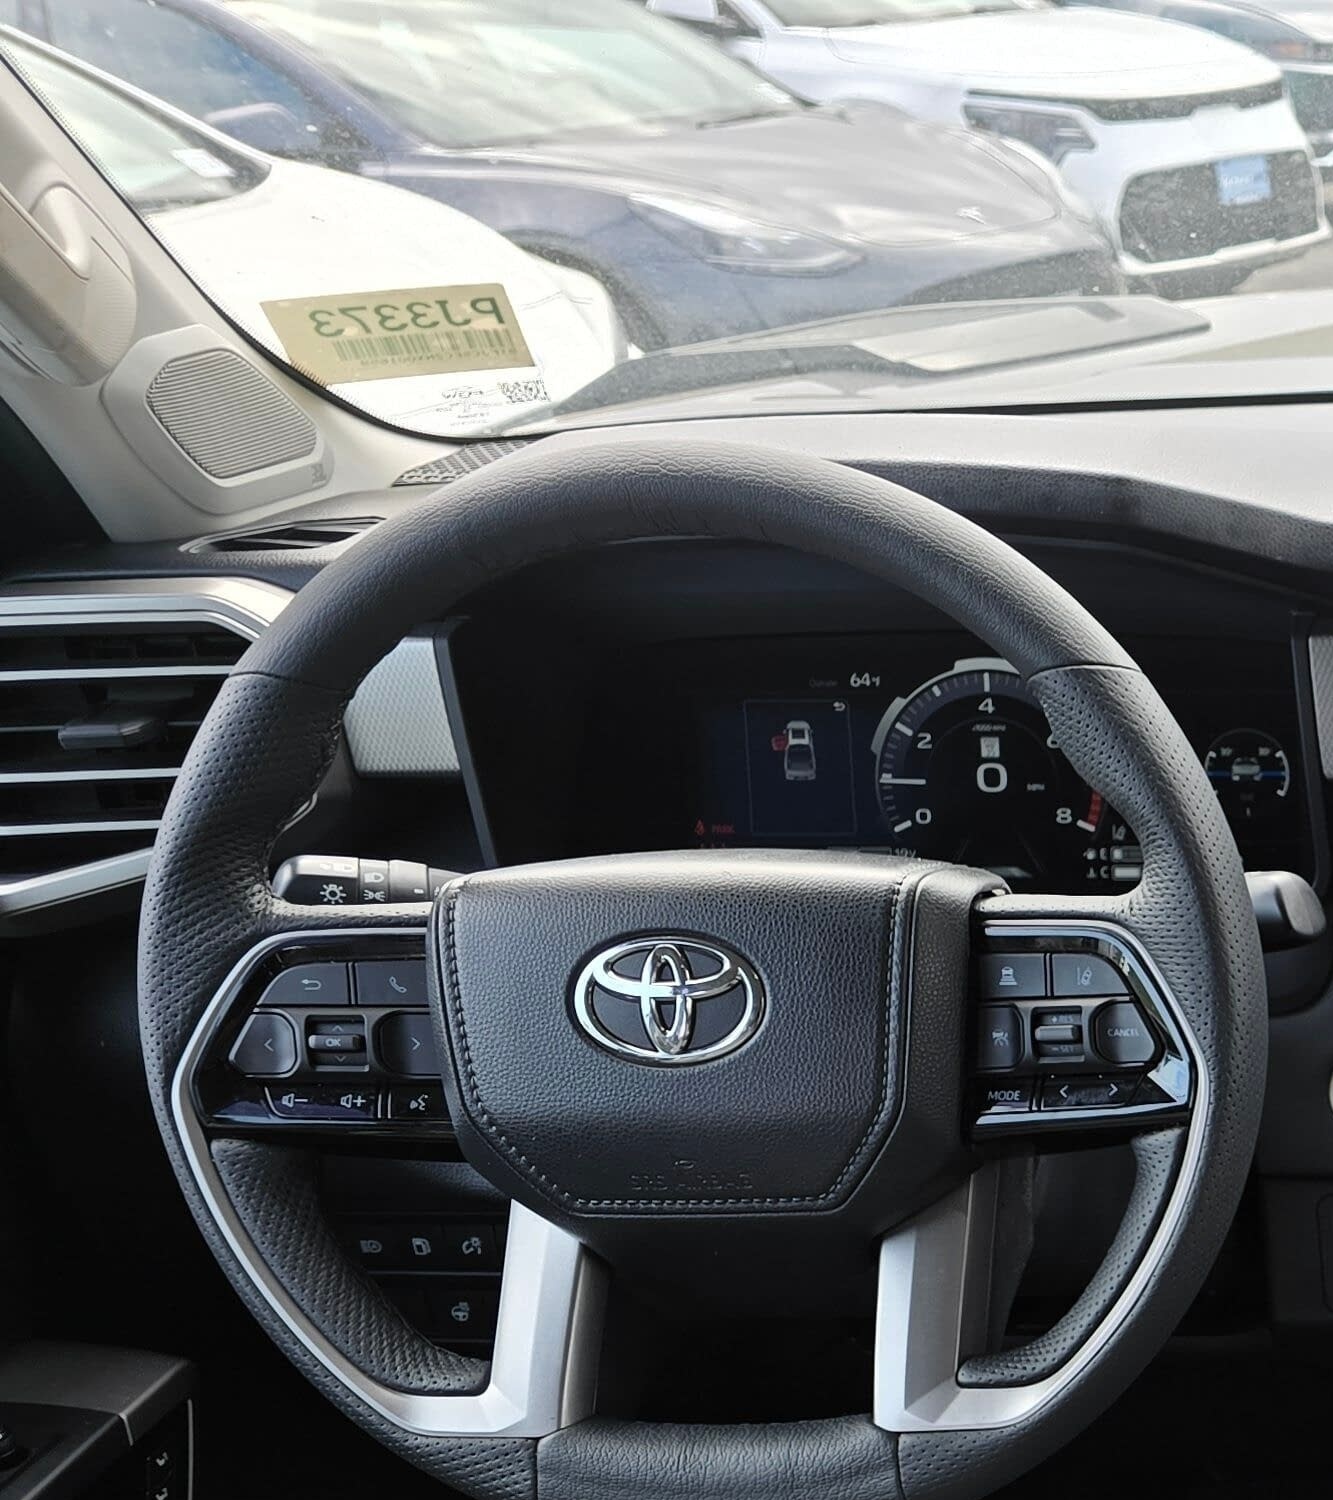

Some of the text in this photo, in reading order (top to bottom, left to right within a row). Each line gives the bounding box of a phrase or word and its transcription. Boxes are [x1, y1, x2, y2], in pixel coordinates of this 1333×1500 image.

[978, 697, 995, 714] 4
[916, 732, 933, 750] 2
[976, 762, 1008, 793] 0
[915, 807, 932, 824] 0
[1056, 807, 1072, 824] 8
[1107, 1028, 1139, 1038] CANCEL
[325, 1038, 342, 1047] OK
[987, 1090, 1021, 1101] MODE
